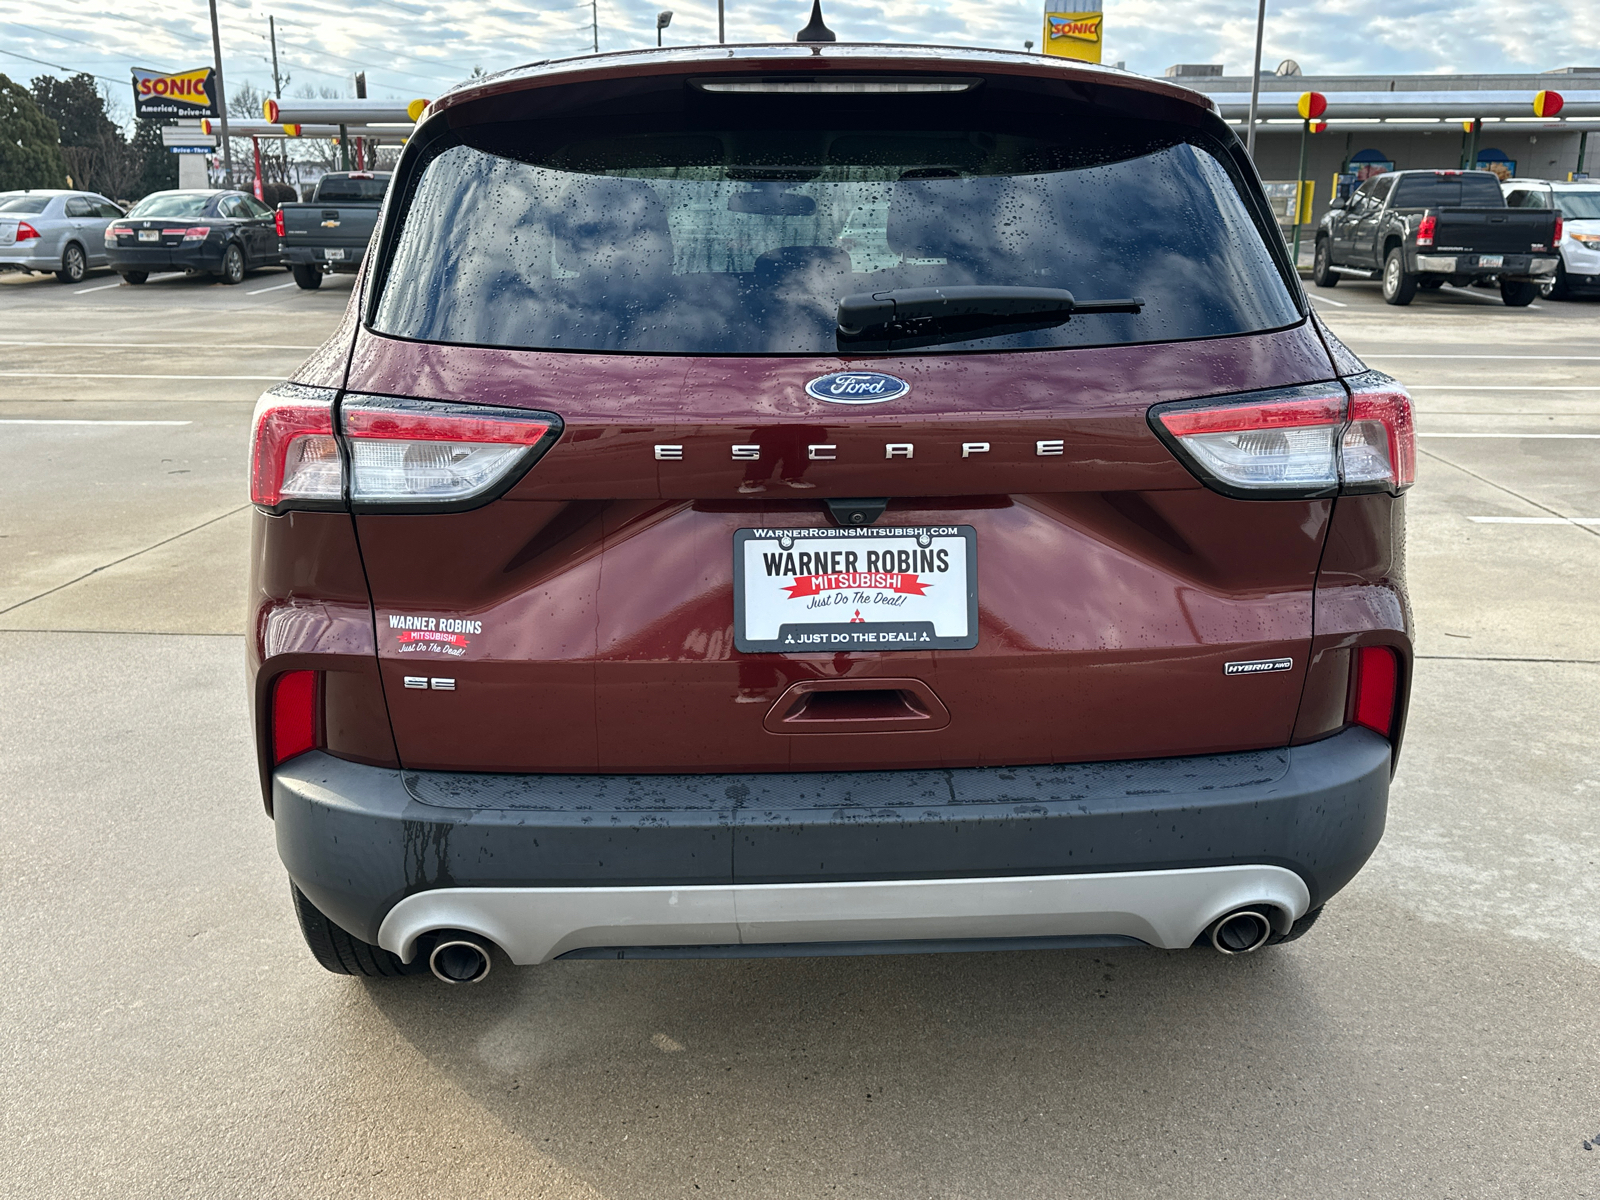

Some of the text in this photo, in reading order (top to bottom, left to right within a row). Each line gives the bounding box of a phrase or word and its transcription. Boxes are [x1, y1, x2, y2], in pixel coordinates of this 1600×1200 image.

[1053, 23, 1097, 34] SONIC
[141, 78, 206, 95] SONIC
[141, 104, 211, 116] America's Drive-In
[830, 375, 885, 394] Ford
[654, 440, 1064, 460] ESCAPE
[763, 549, 949, 576] WARNER ROBINS
[811, 574, 901, 590] MITSUBISHI
[807, 591, 908, 609] Just Do The Deal!
[389, 615, 482, 634] WARNER ROBINS
[411, 632, 457, 642] MITSUBISHI
[797, 632, 917, 643] JUST DO THE DEAL!
[399, 643, 466, 657] Just Do The Deal!
[1228, 663, 1273, 672] HYBRID
[403, 676, 456, 690] SE
